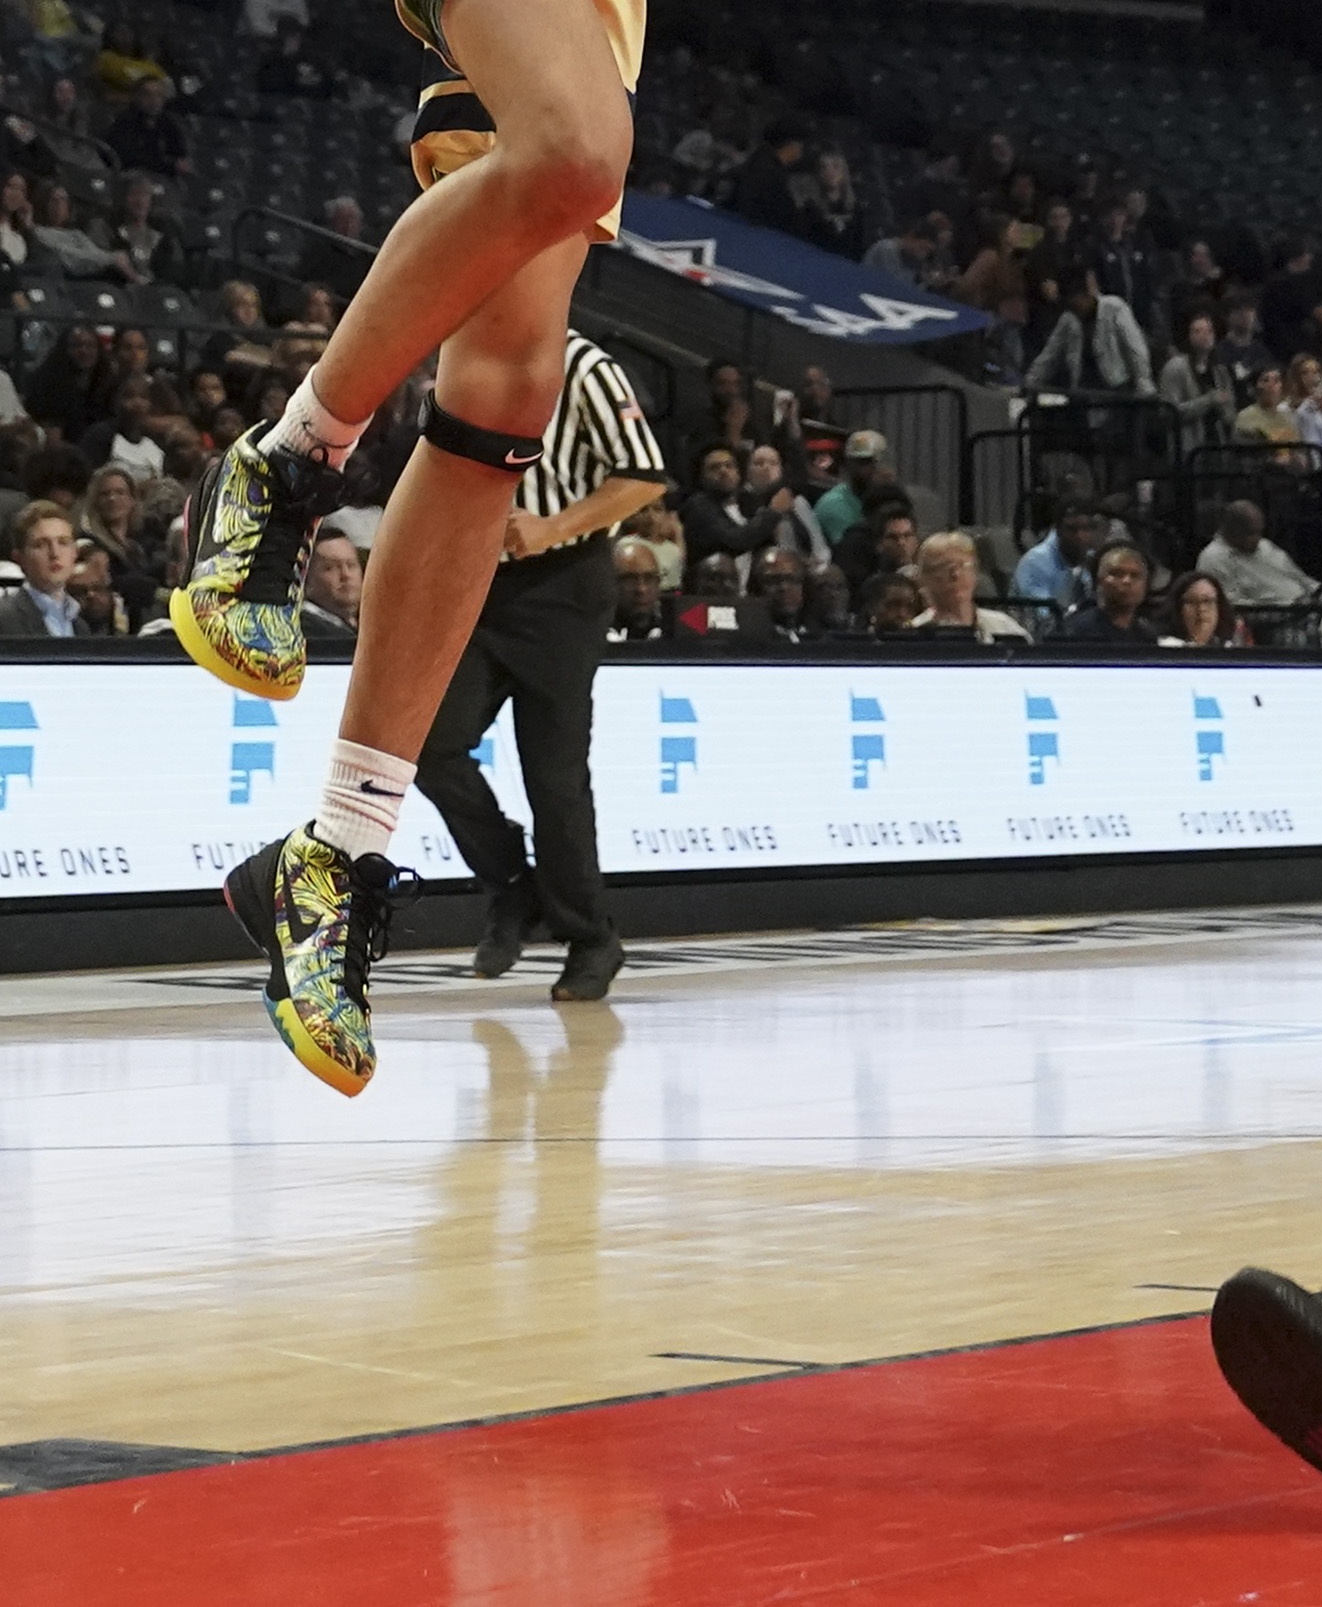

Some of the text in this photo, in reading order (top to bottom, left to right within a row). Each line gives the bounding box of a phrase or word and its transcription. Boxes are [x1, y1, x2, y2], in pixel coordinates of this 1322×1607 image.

[632, 825, 778, 854] FUTURE ONES
[827, 819, 963, 847] FUTURE ONES
[1007, 813, 1132, 841] FUTURE ONES
[60, 845, 130, 876] ONES
